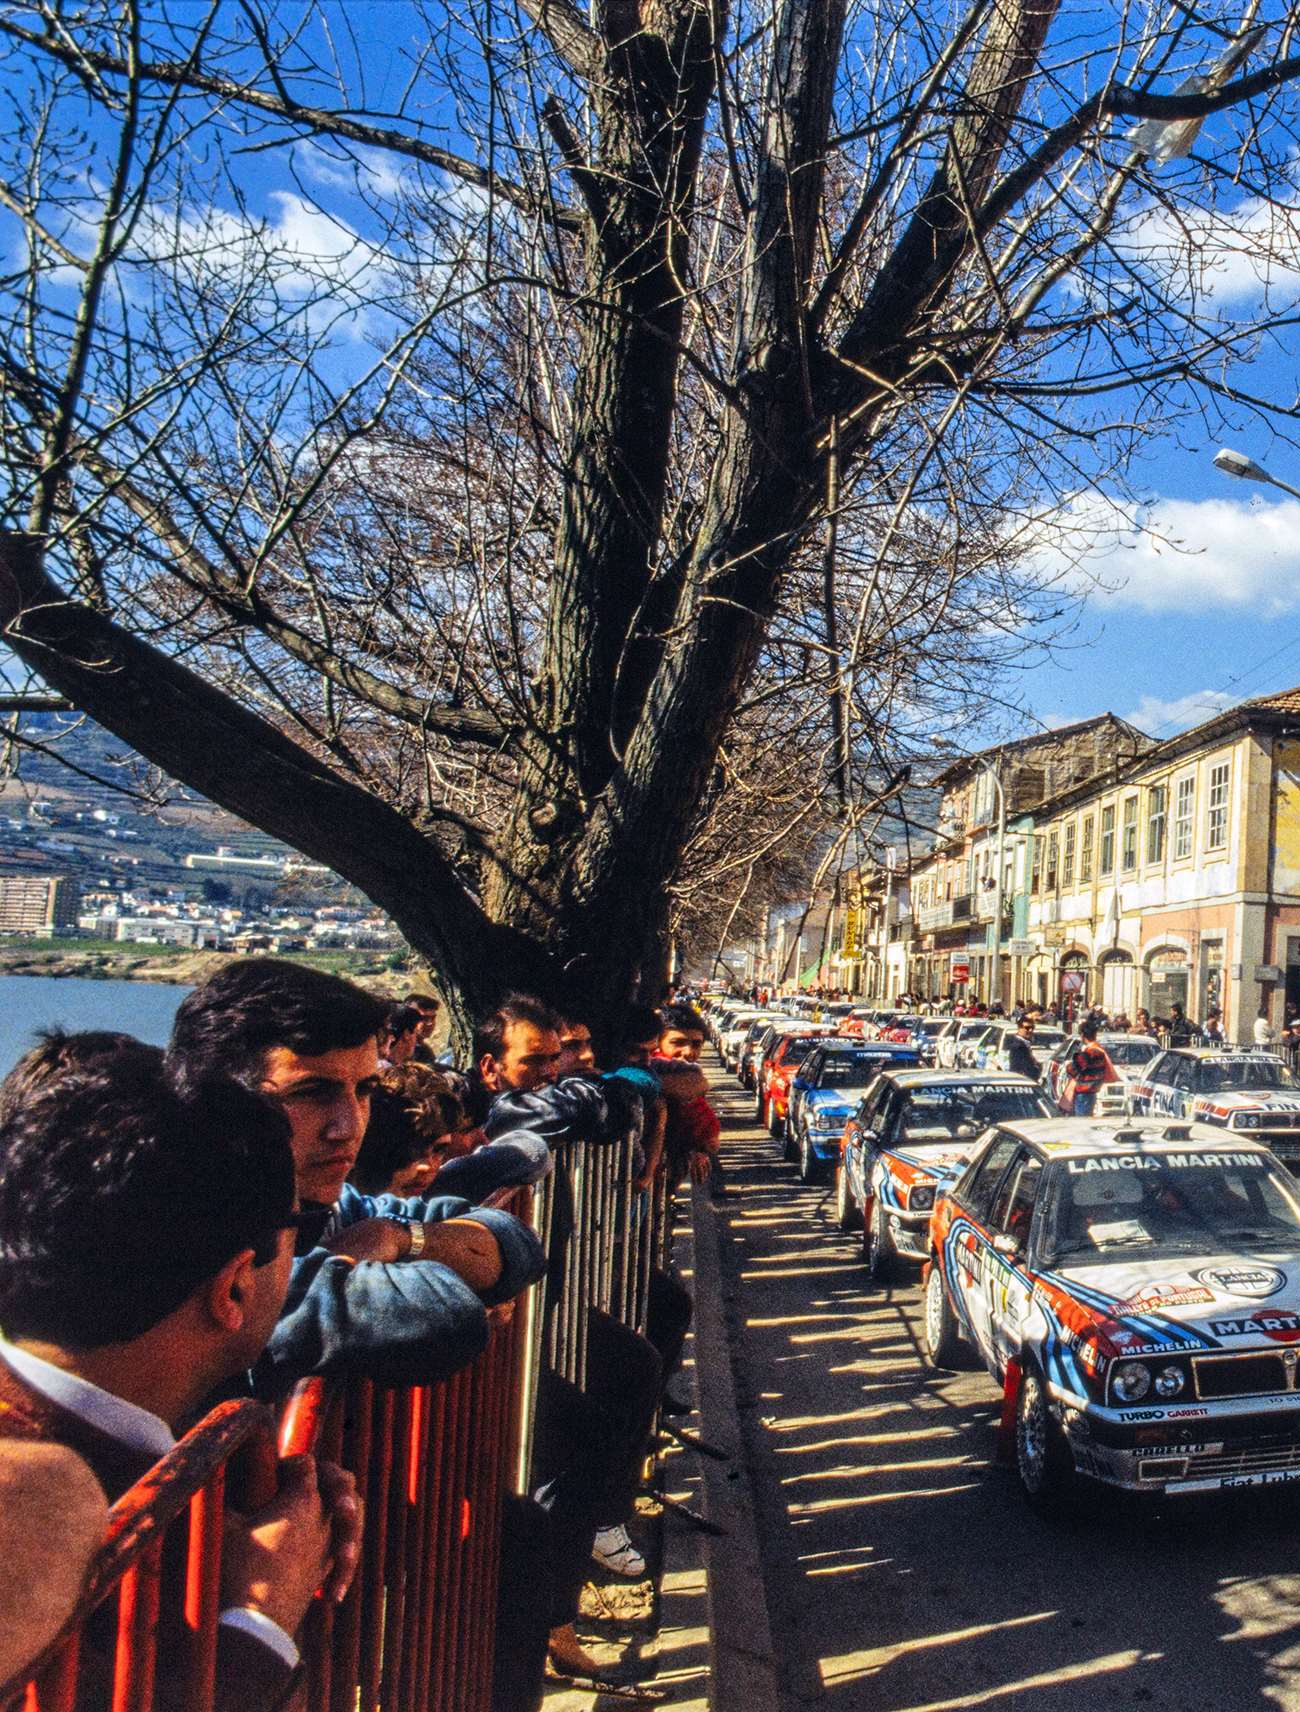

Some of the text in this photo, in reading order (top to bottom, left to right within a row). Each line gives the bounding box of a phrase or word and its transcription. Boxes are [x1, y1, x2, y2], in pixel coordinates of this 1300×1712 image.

[912, 1086, 1034, 1095] LANCIA MARTINI
[1154, 1088, 1175, 1113] FINA
[1068, 1154, 1264, 1174] LANCIA MARTINI
[1062, 1324, 1107, 1373] MICHELIN
[1120, 1340, 1201, 1355] MICHELIN
[1119, 1408, 1208, 1422] TURBO GARRETT
[1220, 1478, 1255, 1488] Fiat
